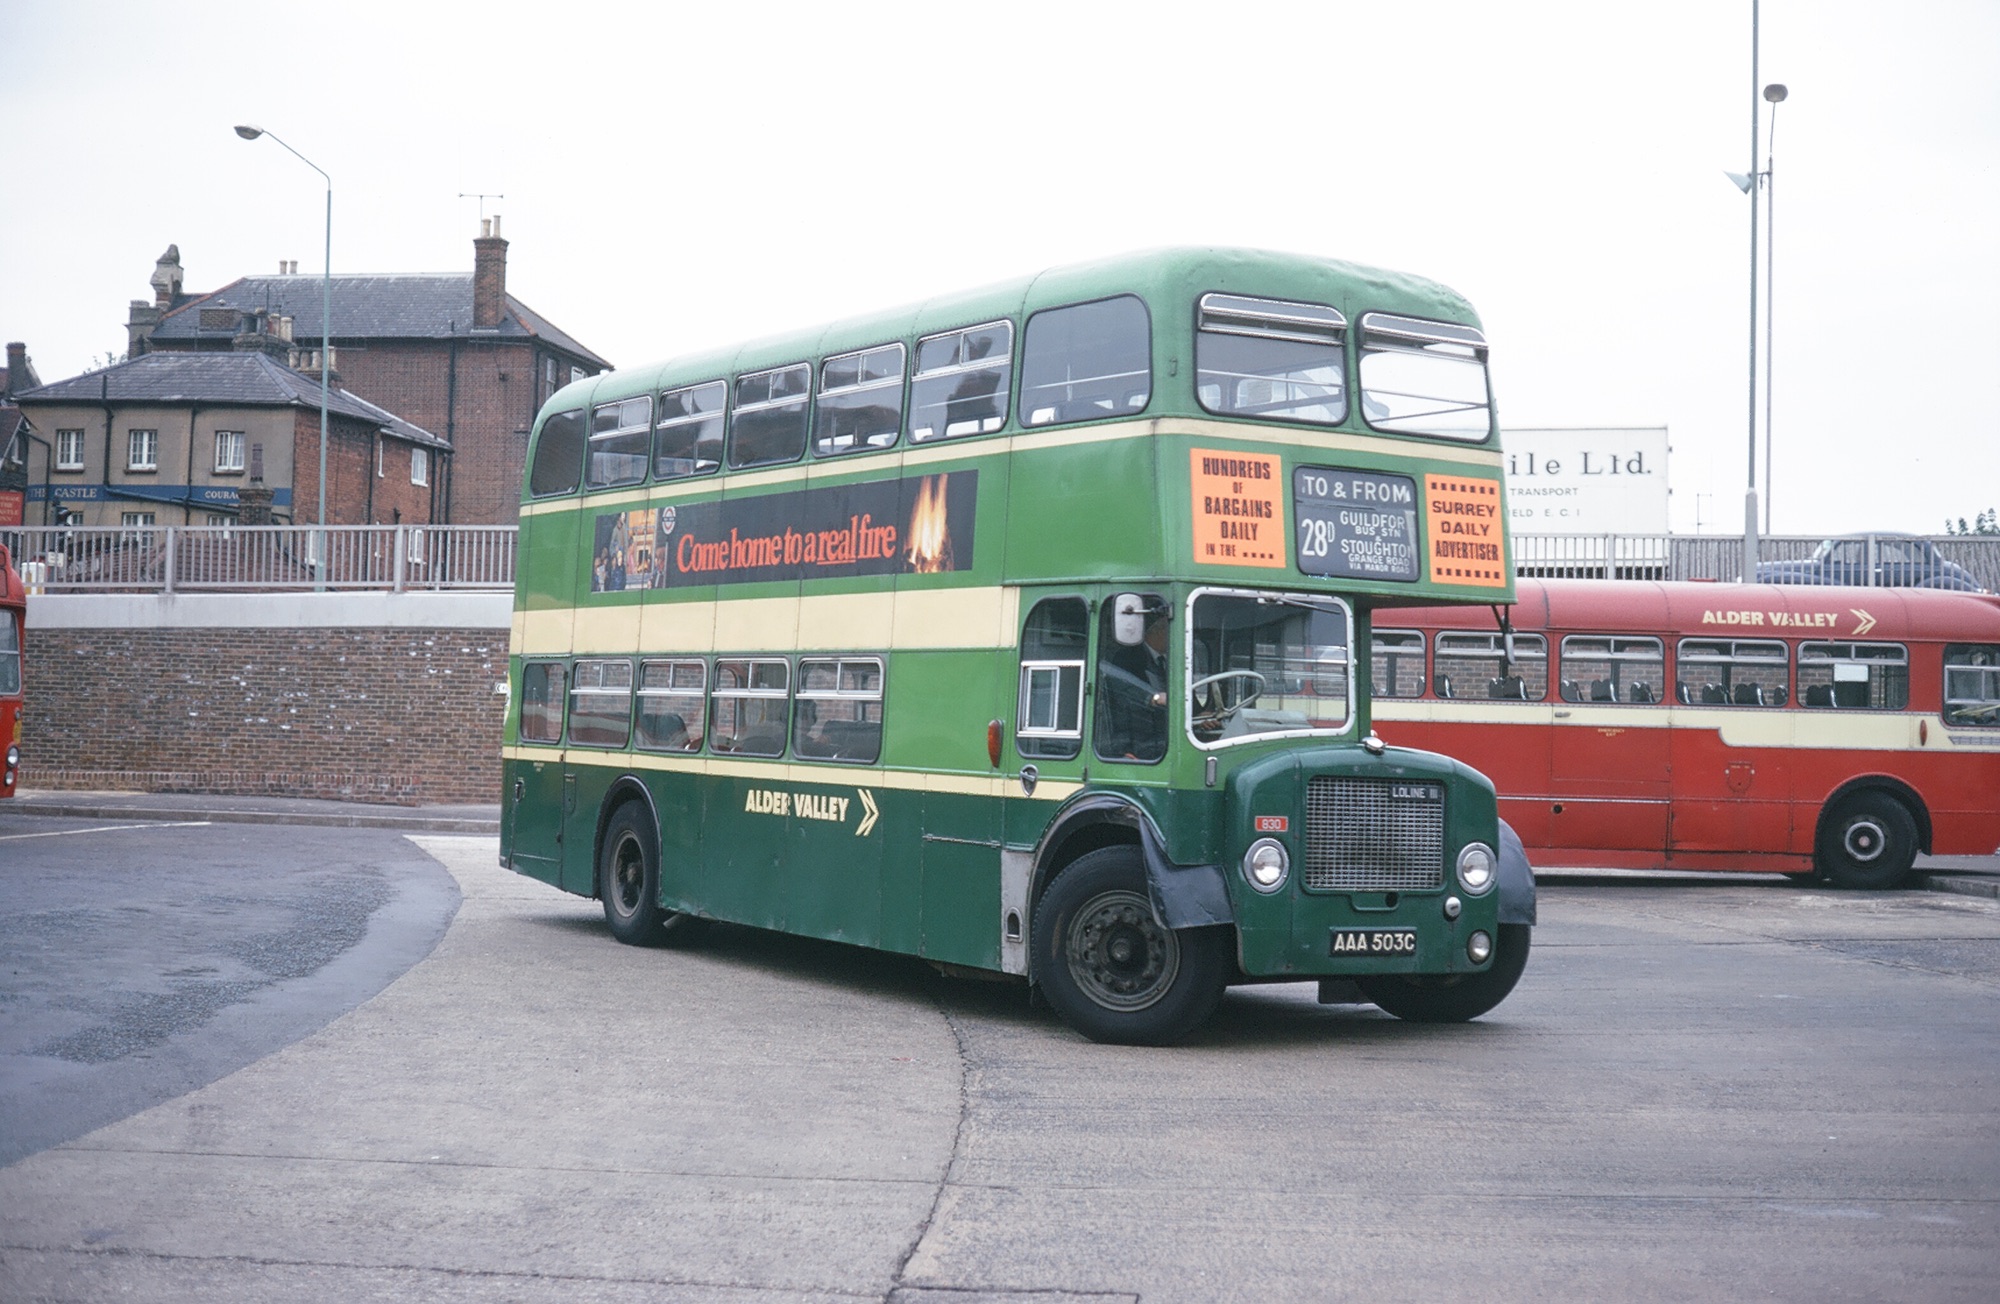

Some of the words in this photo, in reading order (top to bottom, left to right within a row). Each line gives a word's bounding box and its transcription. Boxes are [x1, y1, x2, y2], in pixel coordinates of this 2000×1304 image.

[1202, 457, 1270, 480] HUNDREDS
[1508, 452, 1561, 476] ile
[1580, 451, 1652, 476] Ltd.
[54, 487, 97, 498] CASTLE
[204, 490, 240, 500] COURA
[1232, 481, 1243, 494] OF
[1303, 475, 1328, 497] TO
[1333, 482, 1347, 499] &
[1352, 480, 1407, 503] FROM
[1509, 487, 1579, 496] TRANSPORT
[1204, 496, 1272, 519] BARGAINS
[1432, 501, 1496, 517] SURREY
[1507, 509, 1534, 517] ELD
[1340, 511, 1406, 530] GUILDFOR
[1441, 521, 1490, 536] DAILY
[1221, 521, 1258, 541] DAILY
[1355, 526, 1376, 536] BUS
[1381, 528, 1401, 537] STN
[676, 534, 728, 573] Come
[729, 527, 783, 569] home
[783, 526, 801, 565] to
[804, 532, 817, 563] a
[817, 514, 857, 564] real
[856, 513, 896, 559] fire
[1206, 543, 1216, 556] IN
[1220, 544, 1236, 557] THE
[1436, 540, 1499, 561] ADVERTISER
[1348, 553, 1383, 564] GRANGE
[1386, 556, 1410, 567] ROAD
[1702, 610, 1764, 625] ALDER
[1768, 612, 1838, 627] VALLEY
[1392, 786, 1426, 799] LOLINE
[745, 789, 791, 816] ALDER
[793, 793, 849, 822] VALLEY
[1261, 818, 1281, 830] 830
[1334, 933, 1368, 951] AAA
[1371, 933, 1415, 951] 503C
